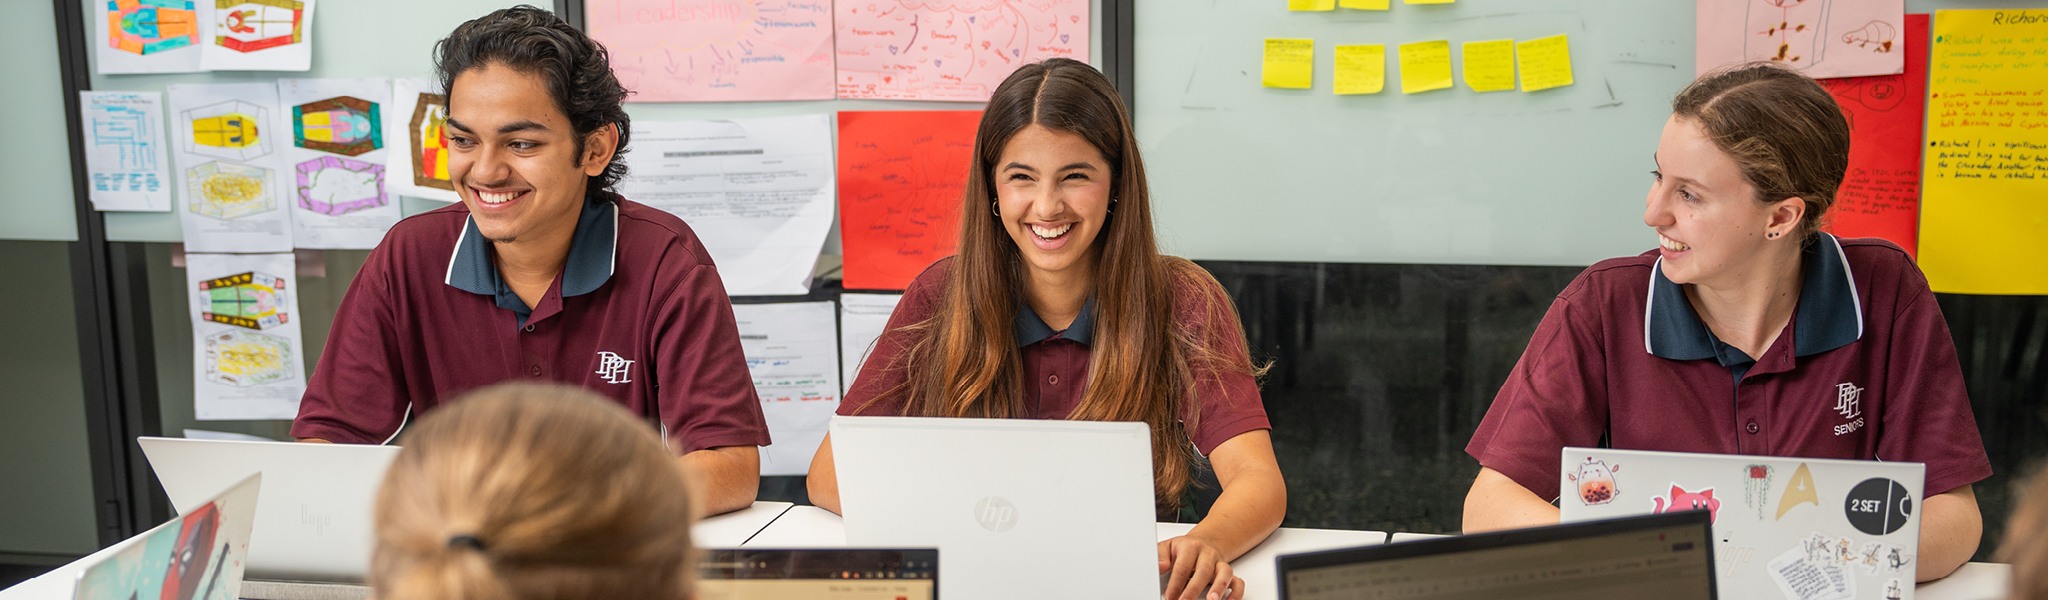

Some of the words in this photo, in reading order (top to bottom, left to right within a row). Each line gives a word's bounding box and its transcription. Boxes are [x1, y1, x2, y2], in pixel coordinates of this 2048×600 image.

[616, 0, 741, 25] Leadership
[977, 495, 1014, 532] hp
[1850, 498, 1860, 512] 2
[1860, 499, 1881, 513] SET
